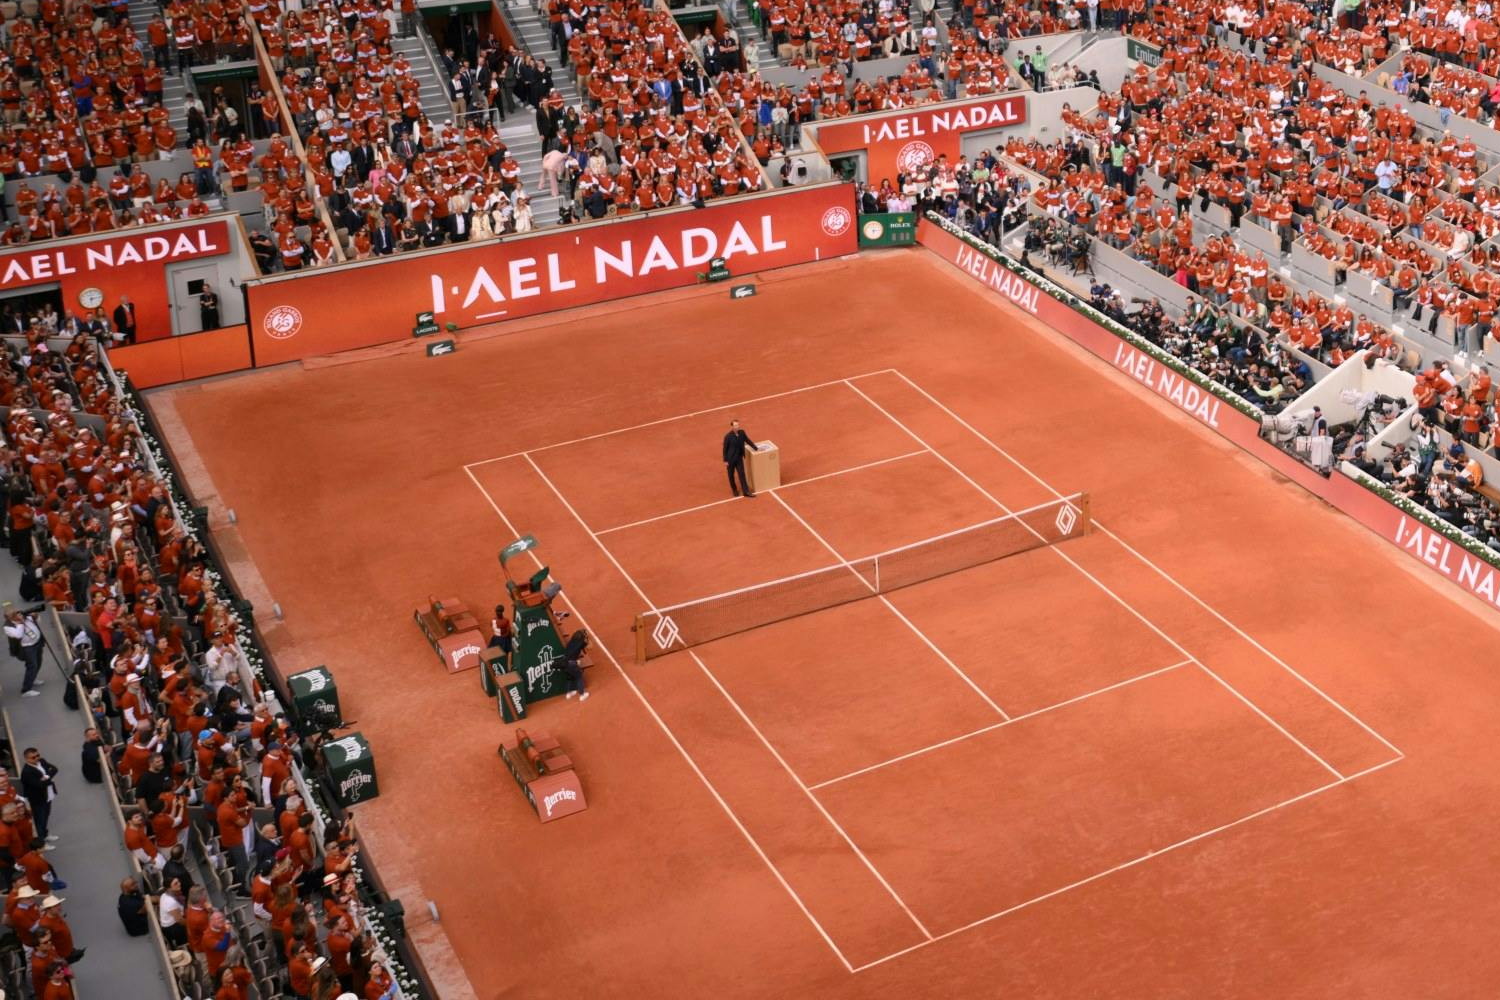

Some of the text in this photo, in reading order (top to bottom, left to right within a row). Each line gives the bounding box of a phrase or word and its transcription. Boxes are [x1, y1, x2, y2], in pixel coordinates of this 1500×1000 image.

[1135, 44, 1161, 64] Emirat
[931, 101, 1018, 133] NADAL
[86, 229, 218, 270] NADAL
[593, 214, 787, 284] NADAL
[991, 265, 1040, 313] NADAL
[1158, 369, 1219, 427] NADAL
